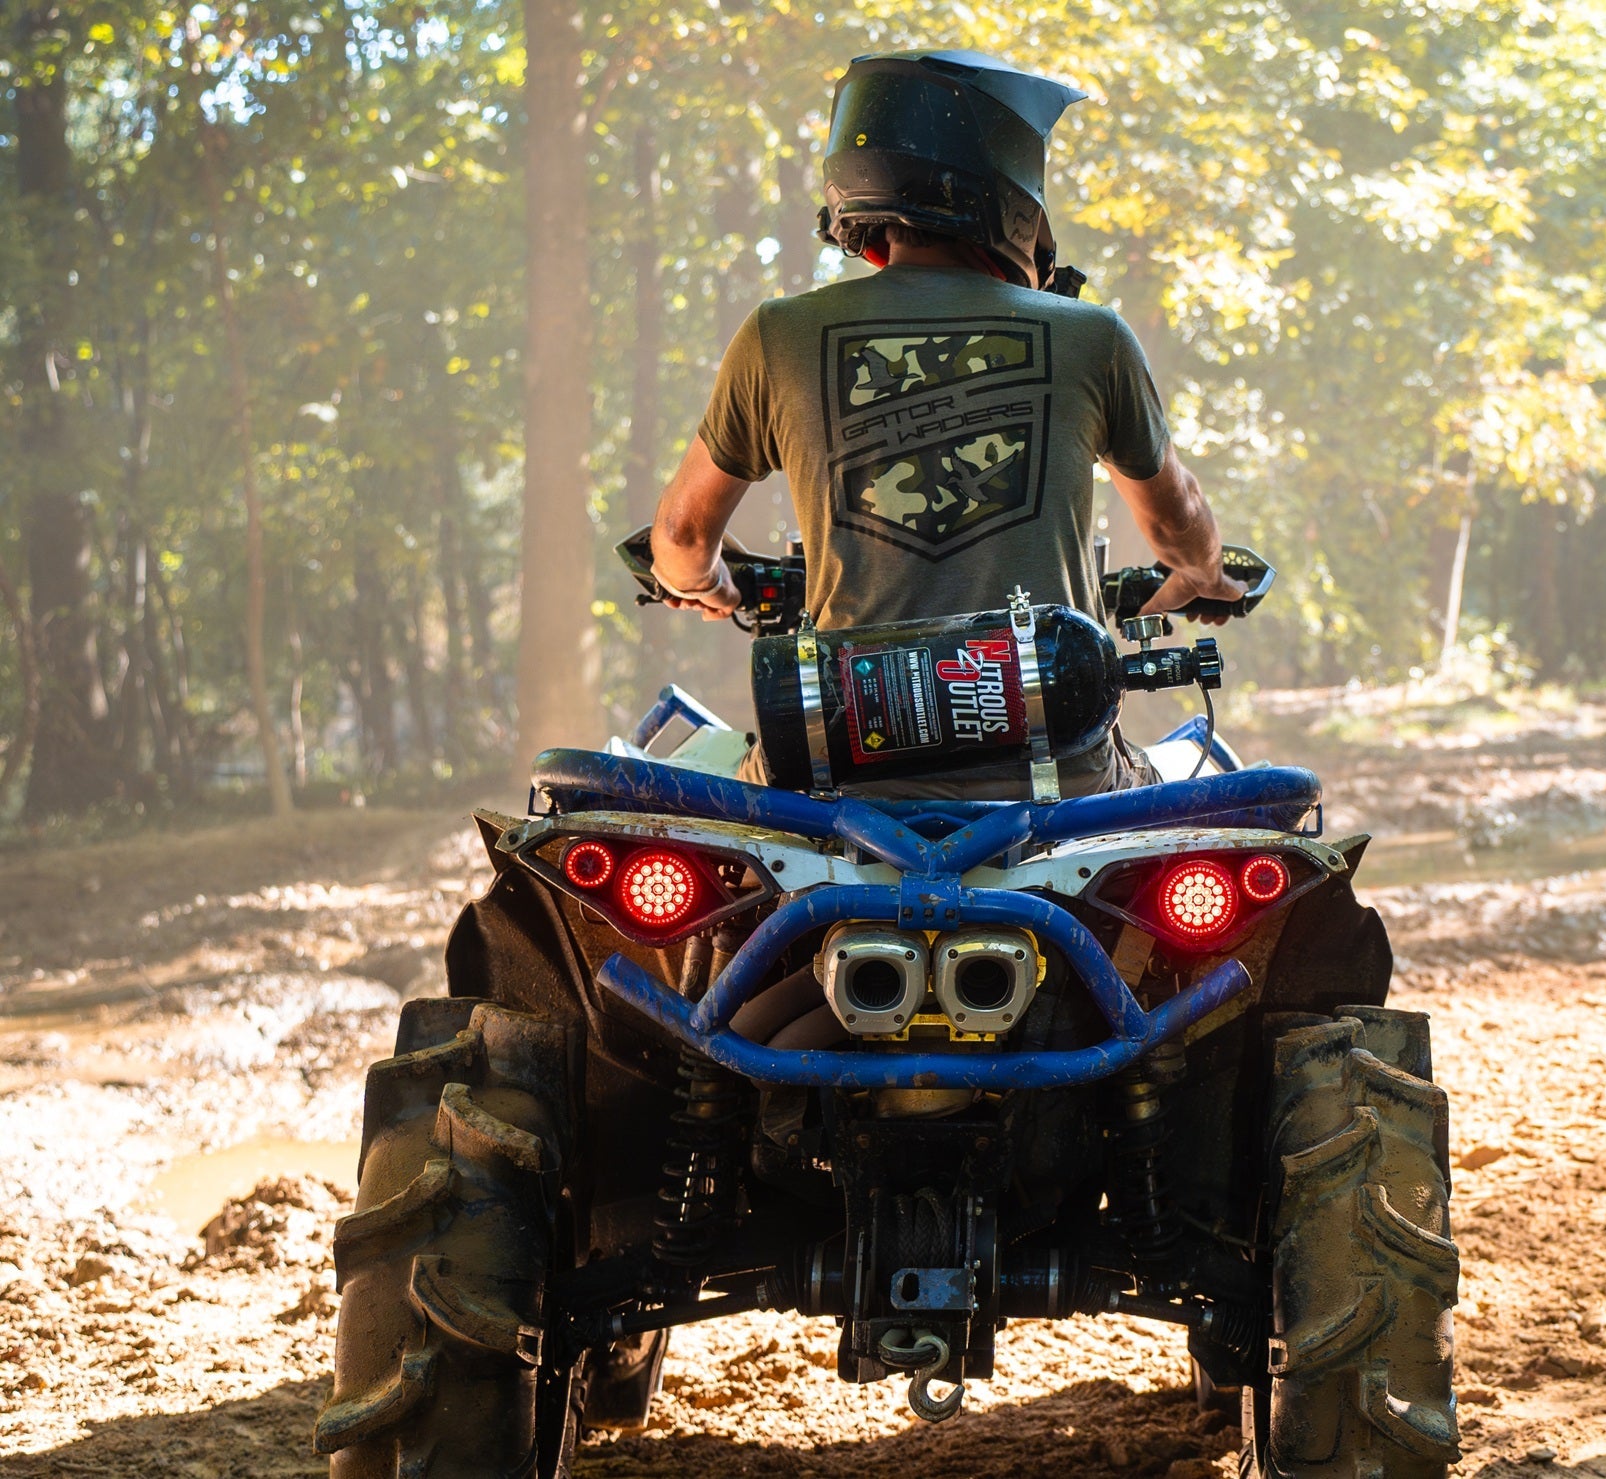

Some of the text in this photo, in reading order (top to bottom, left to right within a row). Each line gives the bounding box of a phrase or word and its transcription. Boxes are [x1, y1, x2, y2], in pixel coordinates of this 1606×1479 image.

[842, 395, 955, 441] GATOR
[897, 400, 1034, 444] WADERS
[936, 660, 983, 741] OUTLET
[965, 640, 1011, 733] NITROUS
